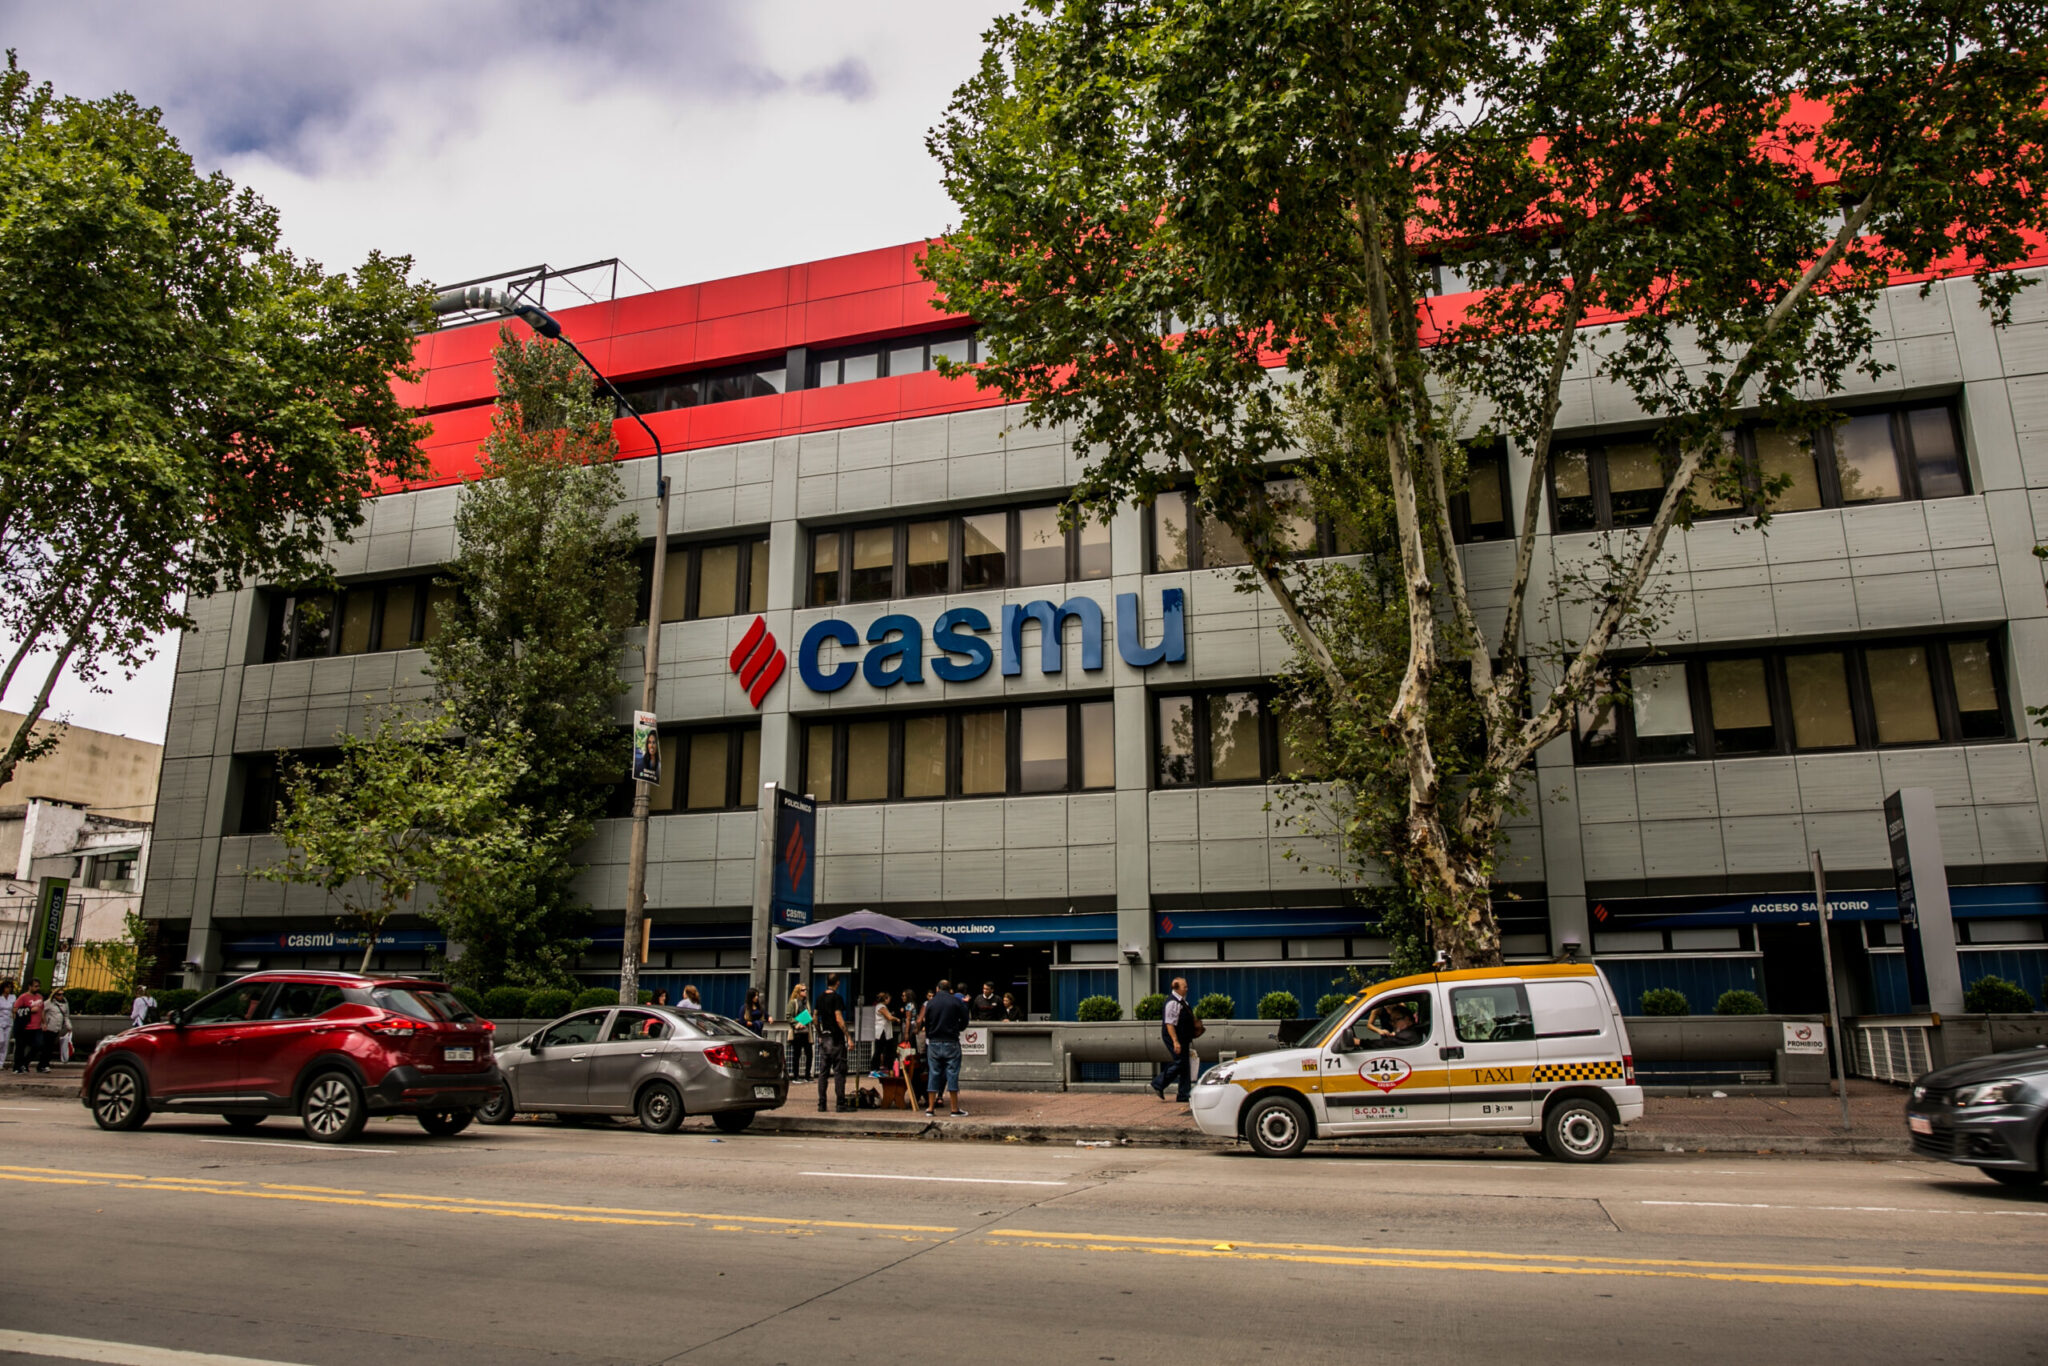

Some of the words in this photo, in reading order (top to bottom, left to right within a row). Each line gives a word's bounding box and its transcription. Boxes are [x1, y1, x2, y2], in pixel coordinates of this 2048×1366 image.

[799, 588, 1188, 693] casmu
[1751, 903, 1799, 913] ACCESO
[1801, 900, 1869, 912] SAATORIO
[940, 924, 996, 934] POLICLÍNICO
[1787, 1040, 1823, 1048] PROHIBIDO
[1325, 1058, 1342, 1069] 71
[1371, 1059, 1400, 1073] 141
[1471, 1067, 1515, 1083] TAXI
[1354, 1107, 1388, 1115] S.C.O.T.
